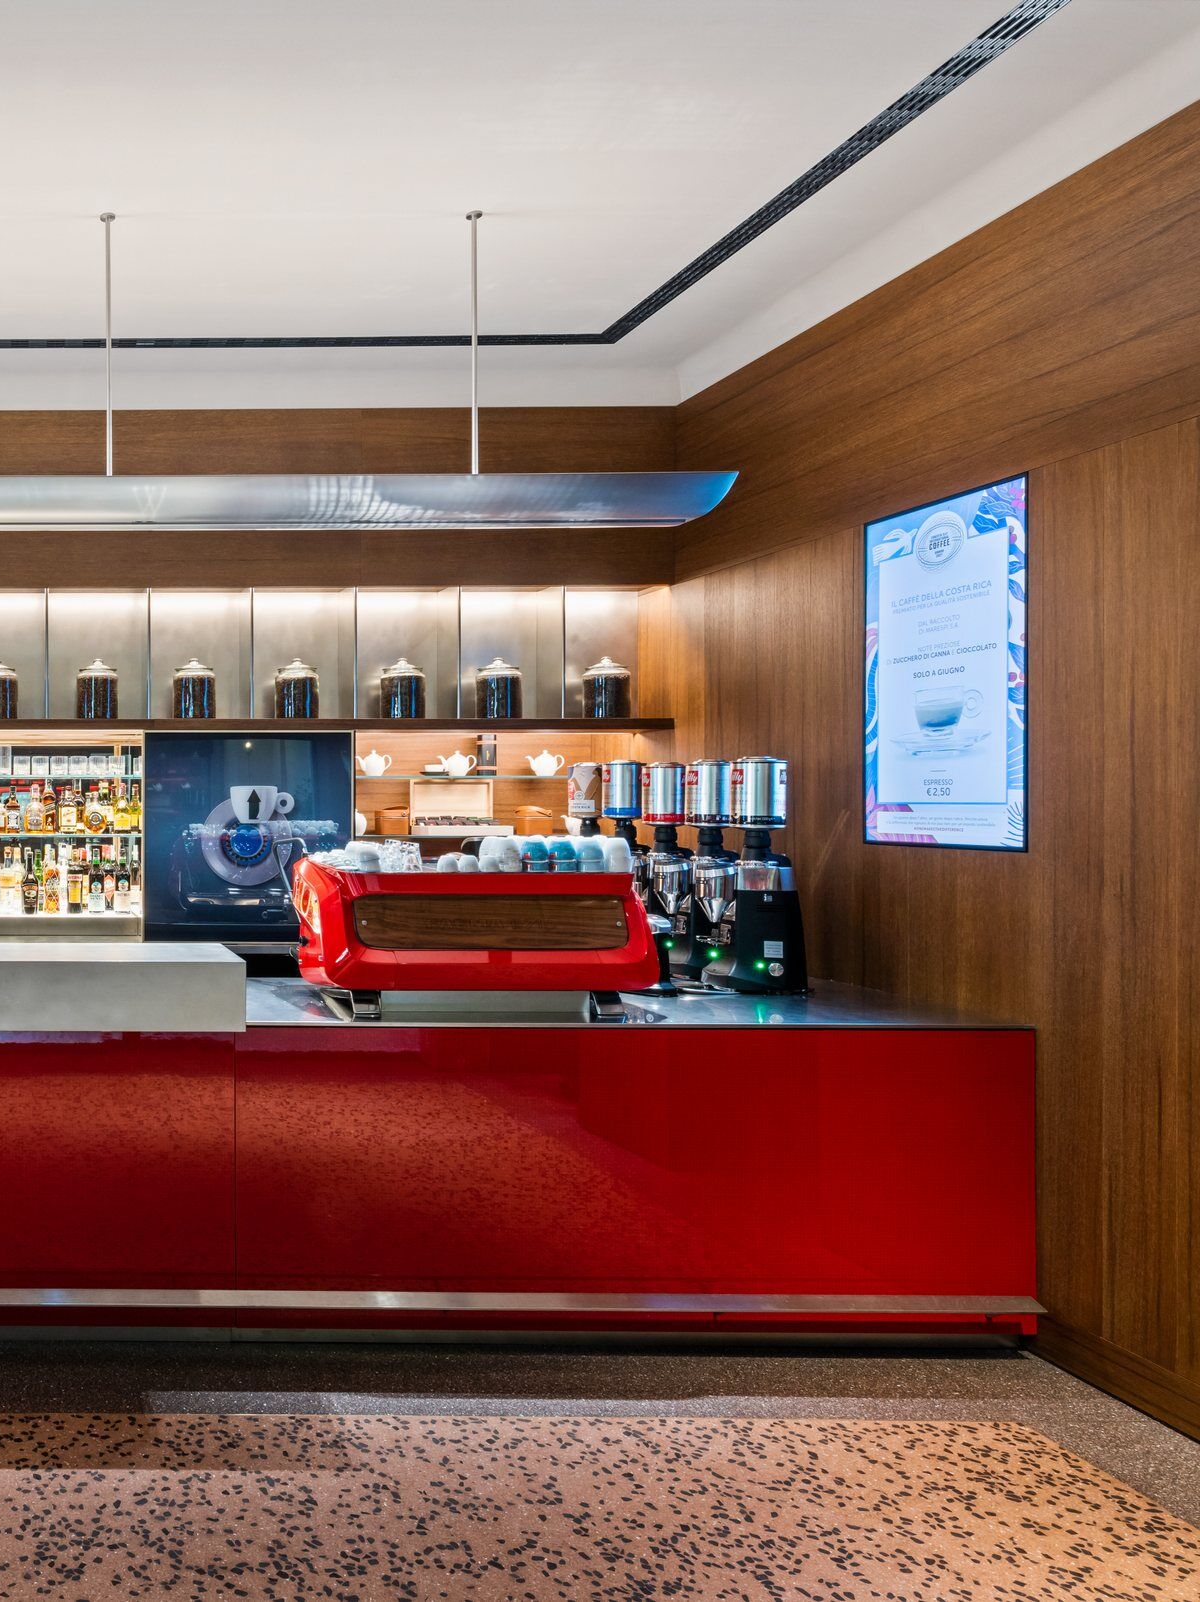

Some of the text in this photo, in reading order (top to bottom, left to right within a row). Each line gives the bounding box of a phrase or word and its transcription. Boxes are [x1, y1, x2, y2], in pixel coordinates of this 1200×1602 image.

[928, 538, 950, 551] COFFEE
[891, 600, 897, 608] IL
[921, 590, 944, 602] DELLA
[945, 584, 972, 597] COSTA
[972, 579, 992, 591] RICA
[892, 653, 923, 665] ZUCCHERO
[930, 649, 951, 659] CANNA
[956, 642, 998, 655] CIOCCOLATO
[912, 665, 966, 679] SOLO A GIUGNO
[923, 778, 954, 786] ESPRESSO
